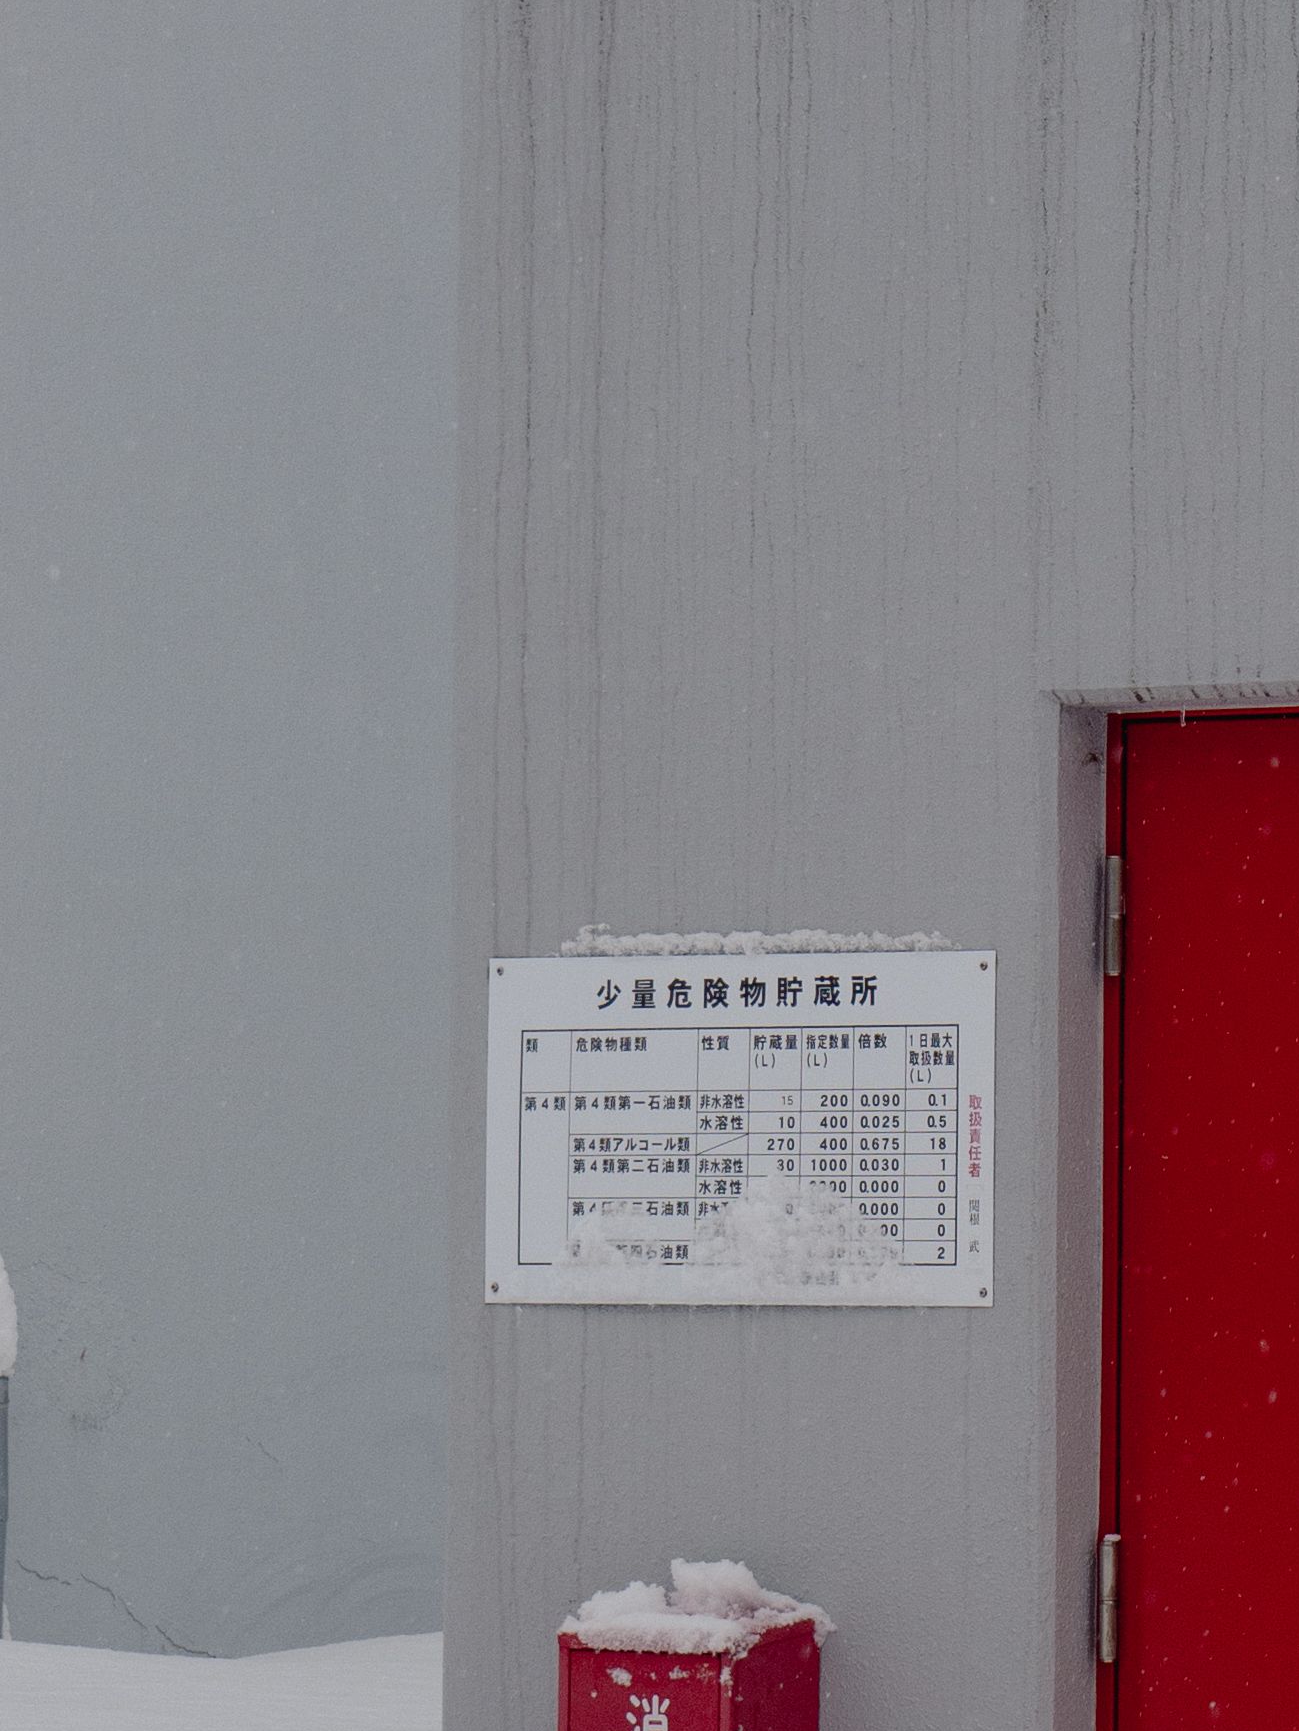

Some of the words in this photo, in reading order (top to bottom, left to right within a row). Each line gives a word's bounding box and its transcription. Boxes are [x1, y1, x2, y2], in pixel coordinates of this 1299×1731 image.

[596, 976, 878, 1009] 少量危険物貯蔵所
[525, 1038, 538, 1052] 類
[575, 1037, 647, 1052] 危険物種類
[702, 1036, 730, 1051] 性質
[753, 1035, 797, 1050] 貯蔵量
[807, 1035, 850, 1049] 指定数量
[858, 1034, 887, 1049] 倍数
[909, 1051, 955, 1066] 取扱数量
[525, 1096, 566, 1111] 第4類
[574, 1095, 691, 1111] 第4類第一石油類
[700, 1094, 744, 1109] 非水溶性
[782, 1096, 793, 1105] 15
[821, 1094, 848, 1107] 200
[861, 1094, 900, 1107] 0.090
[929, 1094, 947, 1107] 0.1
[700, 1115, 743, 1131] 水溶性
[779, 1117, 795, 1129] 10
[820, 1116, 847, 1129] 400
[861, 1115, 899, 1129] 0.025
[927, 1115, 947, 1128] 0.5
[969, 1094, 982, 1178] 取扱責任者
[573, 1137, 689, 1152] 第4類アルコール類
[767, 1138, 795, 1151] 270
[820, 1137, 847, 1151] 400
[860, 1137, 899, 1151] 0.675
[931, 1137, 946, 1150] 18
[573, 1159, 689, 1174] 第4類第二石油類
[699, 1158, 743, 1174] 非水溶性
[777, 1159, 794, 1172] 30
[812, 1159, 847, 1171] 1000
[860, 1158, 899, 1172] 0.030
[940, 1158, 946, 1171] 1
[699, 1179, 742, 1195] 水溶性
[860, 1180, 899, 1193] 0.000
[938, 1180, 945, 1193] 0
[859, 1203, 898, 1215] 0.000
[938, 1203, 945, 1215] 0
[938, 1224, 945, 1237] 0
[937, 1247, 945, 1259] 2
